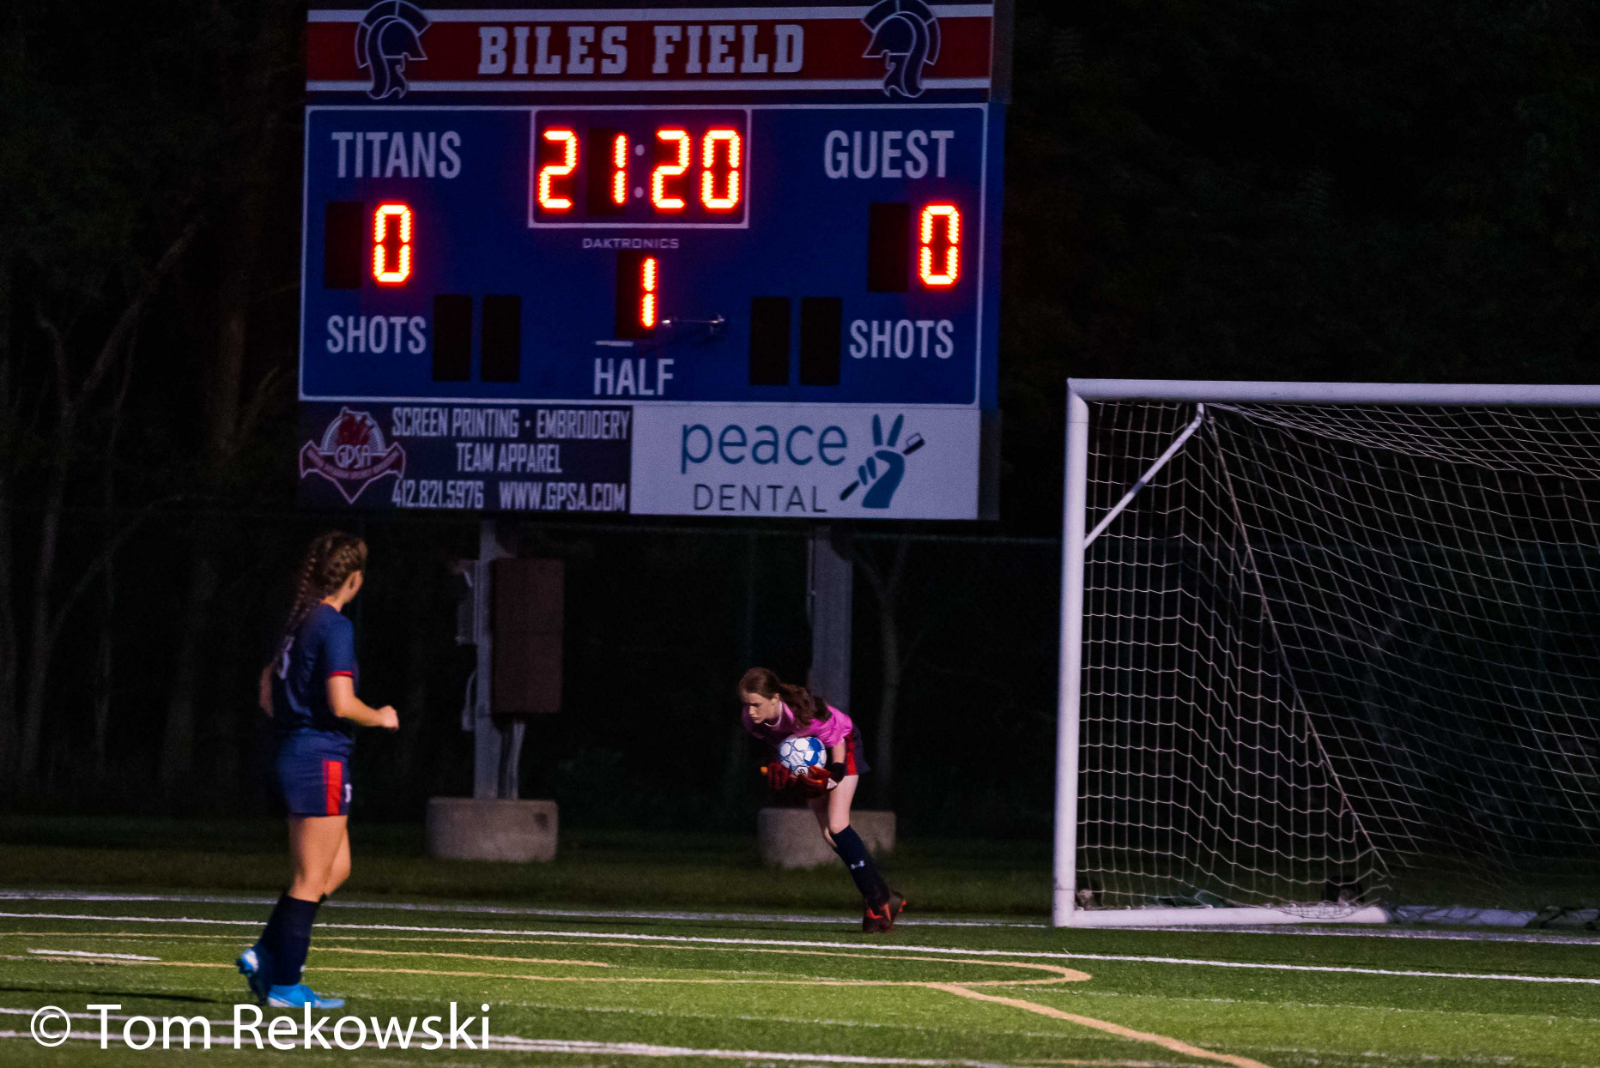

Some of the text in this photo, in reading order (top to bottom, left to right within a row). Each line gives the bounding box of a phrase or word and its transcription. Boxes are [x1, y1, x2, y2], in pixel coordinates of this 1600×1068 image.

[478, 24, 805, 75] BILES FIELD
[331, 130, 462, 179] TITANS
[536, 126, 742, 212] 21:20
[823, 129, 955, 179] GUEST
[372, 202, 413, 286] 0
[581, 238, 680, 250] DAKTRONICS
[918, 203, 960, 287] 0
[640, 256, 659, 329] 1
[326, 314, 427, 355] SHOTS
[849, 319, 955, 359] SHOTS
[593, 357, 675, 397] HALF
[391, 406, 630, 440] SCREEN PRINTING EMBROIDERY
[455, 442, 563, 474] TEAM APPAREL
[681, 423, 848, 474] peace
[391, 479, 627, 512] 412.821.5976 WWW.GPSA.COM
[693, 484, 828, 513] DENTAL
